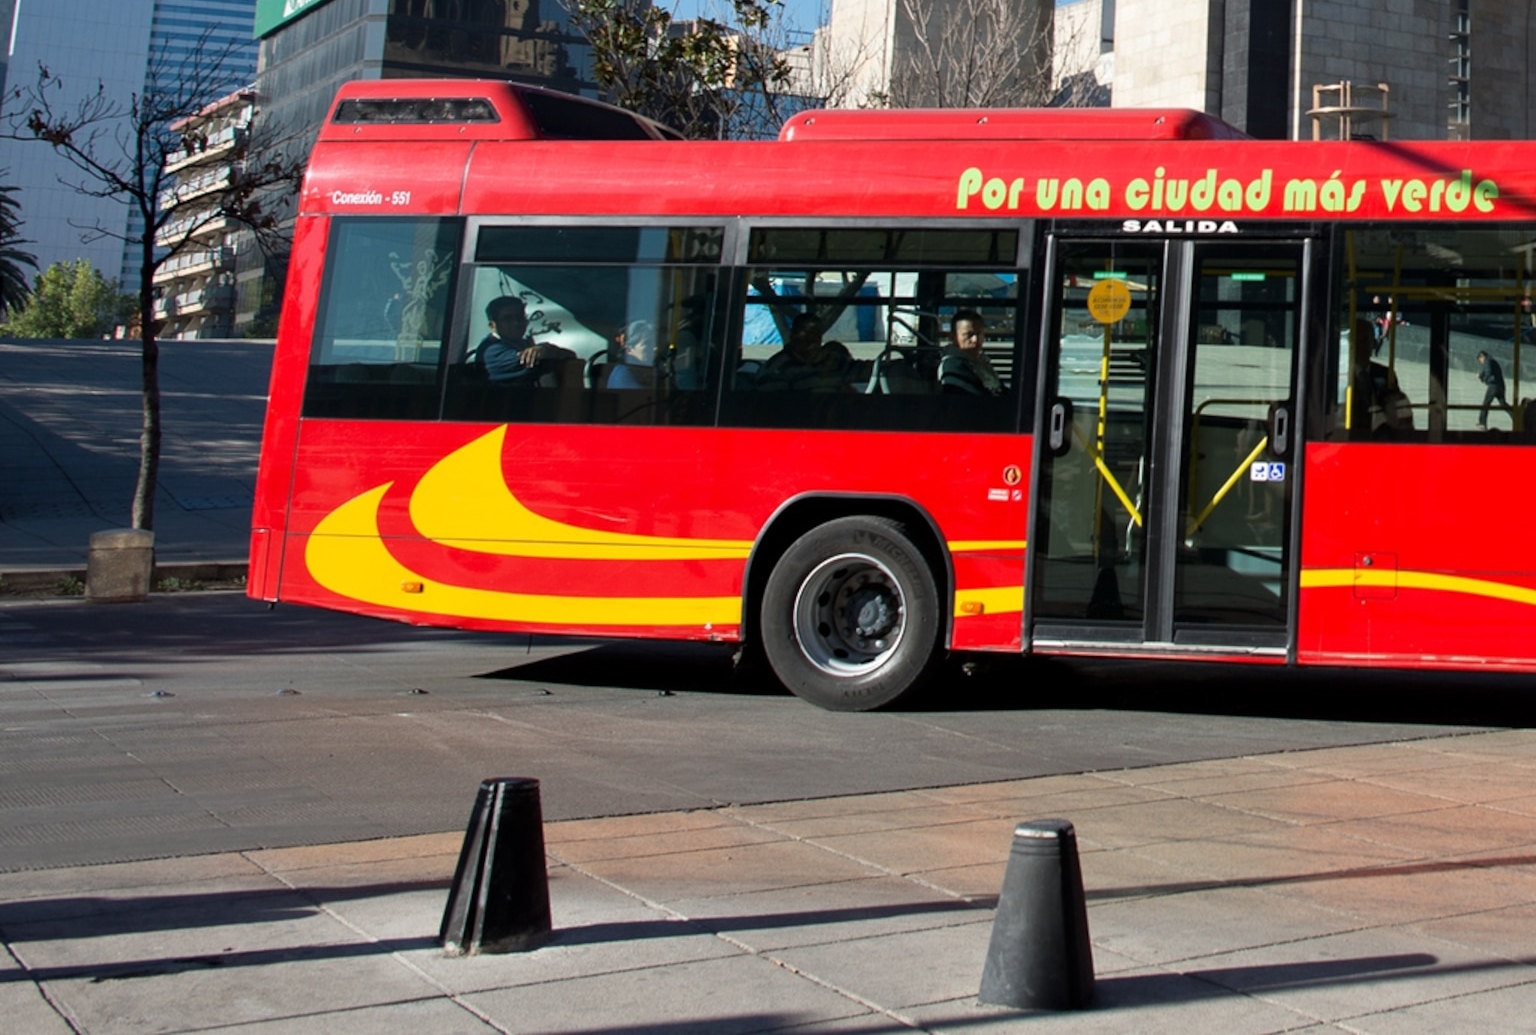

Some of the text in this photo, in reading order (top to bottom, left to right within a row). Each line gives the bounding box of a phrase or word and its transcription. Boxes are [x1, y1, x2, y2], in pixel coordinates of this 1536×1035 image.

[956, 166, 1499, 213] Por una ciudad más verde
[332, 190, 383, 205] Conexión
[391, 190, 411, 205] 551
[1122, 220, 1239, 233] SALIDA
